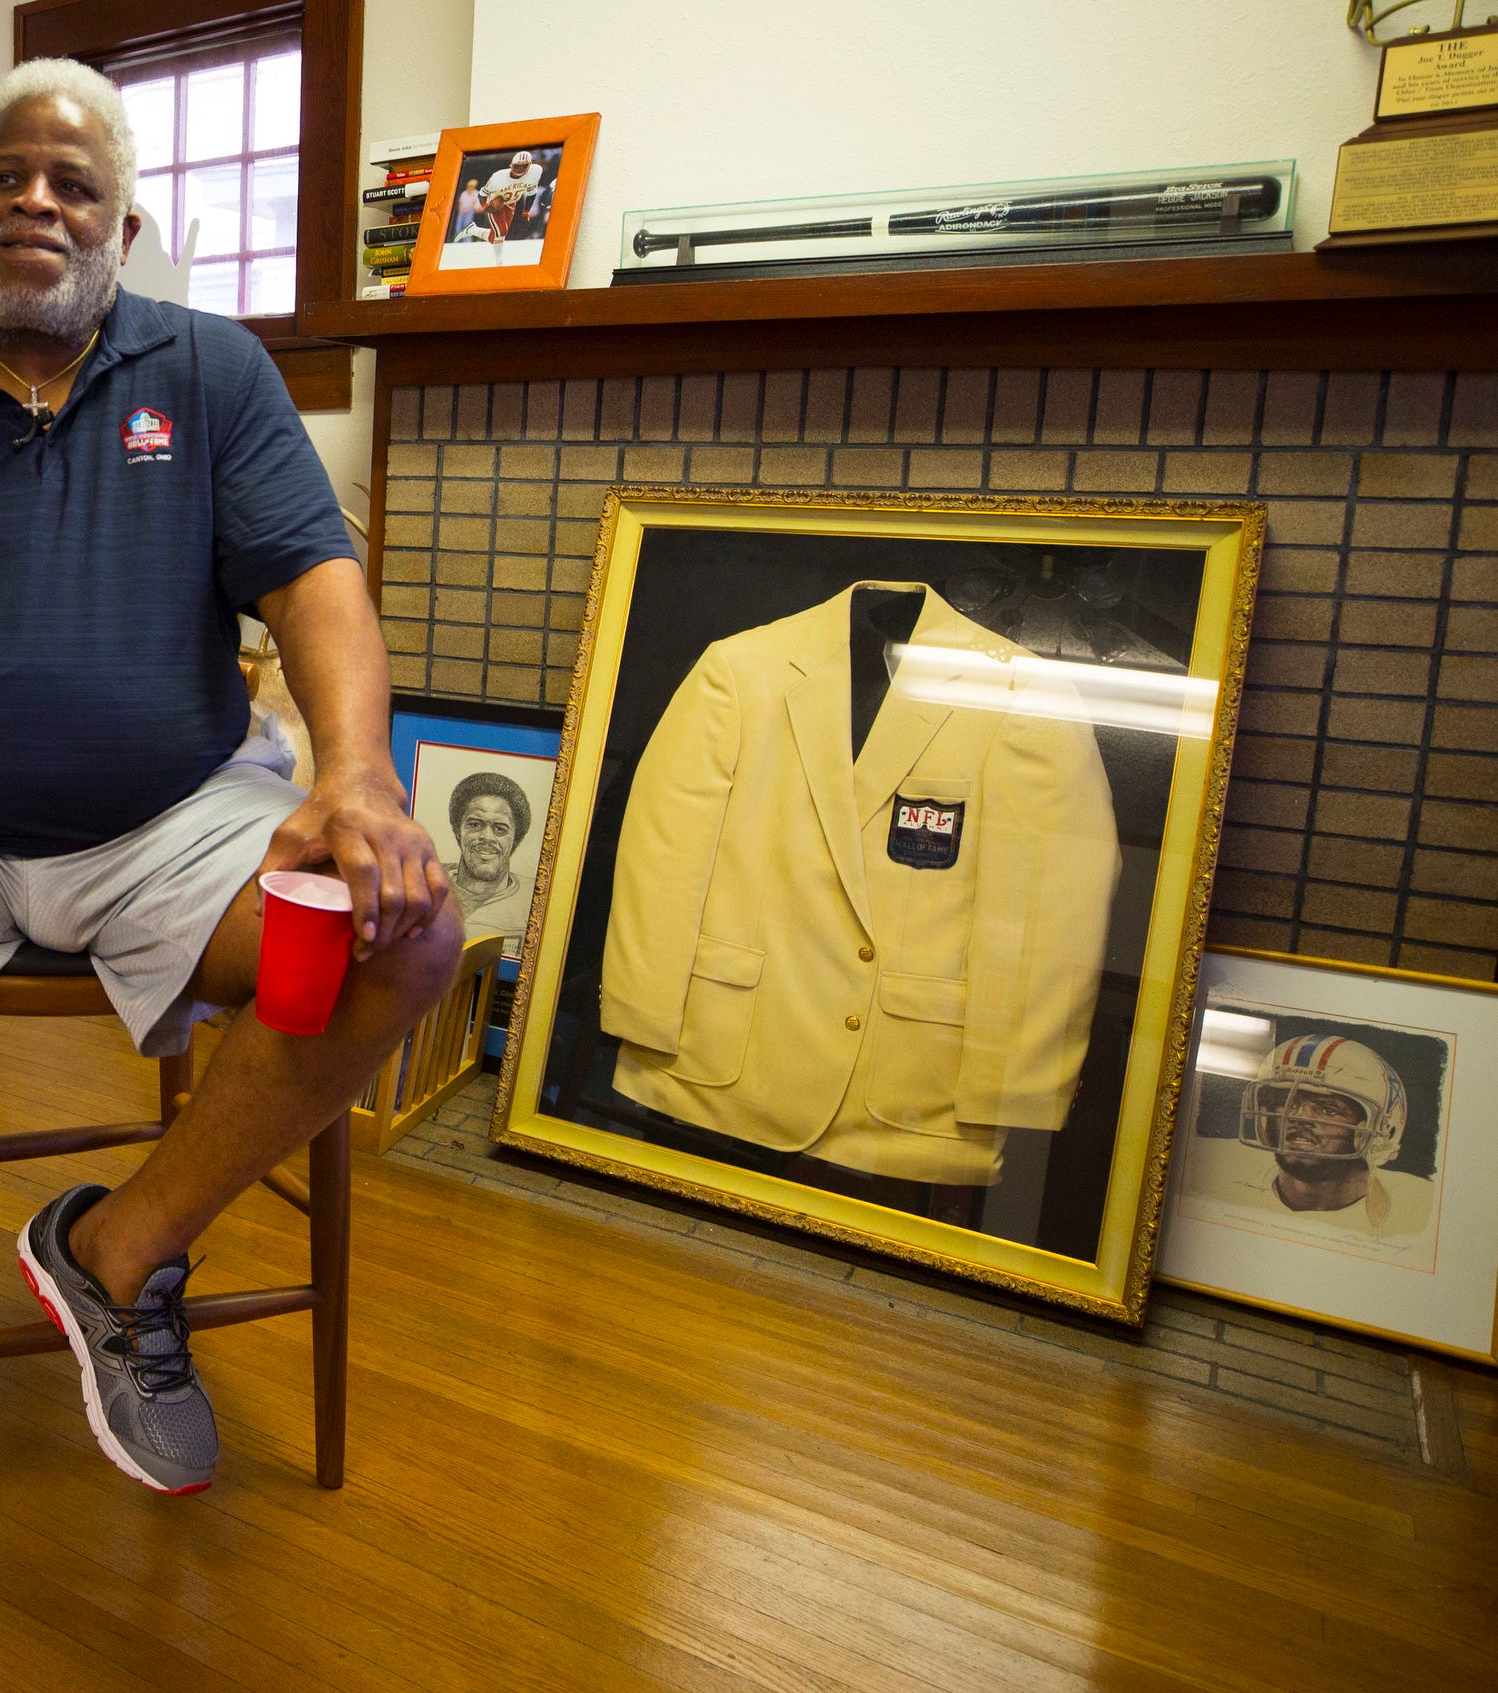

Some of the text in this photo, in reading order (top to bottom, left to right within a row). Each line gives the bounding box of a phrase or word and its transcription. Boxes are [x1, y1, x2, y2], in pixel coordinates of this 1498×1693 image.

[1436, 59, 1466, 70] Award
[365, 187, 405, 199] STUART SCOTT
[1190, 190, 1229, 201] JACKSON
[1155, 204, 1202, 212] PROFESSIONAL
[939, 220, 1003, 231] ADIRONDACK
[375, 248, 392, 258] JOHN
[370, 256, 399, 265] GRISHAM
[907, 807, 948, 827] NFL
